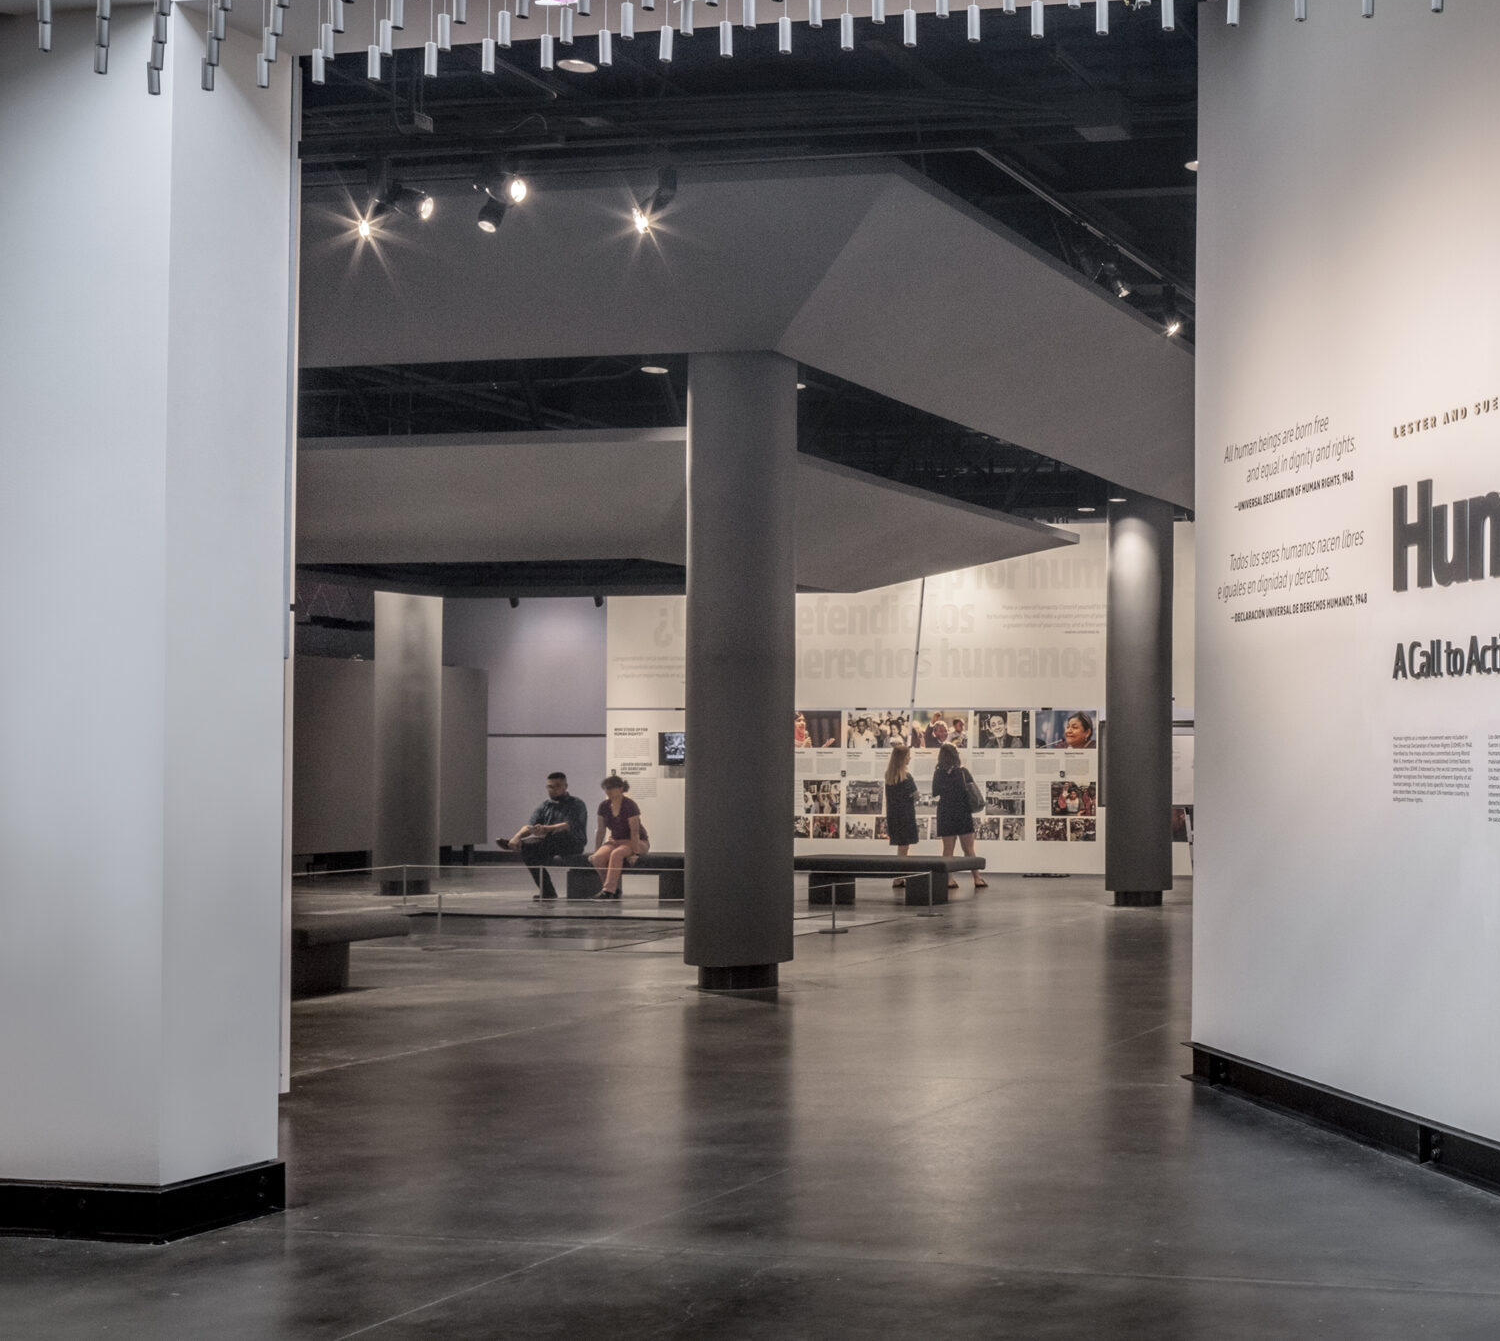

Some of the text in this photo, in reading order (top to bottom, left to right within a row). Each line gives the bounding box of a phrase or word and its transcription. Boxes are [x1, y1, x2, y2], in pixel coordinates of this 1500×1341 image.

[1224, 414, 1329, 464] All human beings are born free
[1392, 415, 1438, 440] LESTER
[1442, 406, 1468, 427] AND
[1474, 396, 1499, 417] SUE
[1246, 462, 1260, 483] and
[1261, 456, 1280, 481] equal
[1281, 453, 1288, 473] in
[1289, 446, 1315, 473] dignity
[1316, 439, 1331, 463] and
[1263, 486, 1294, 505] DECLARATION
[1295, 485, 1301, 496] OF
[1302, 479, 1320, 495] HUMAN
[1321, 474, 1341, 489] RIGHTS,
[1342, 470, 1354, 484] 1948
[1230, 529, 1364, 571] Todos los seres humanos nacen libres
[1217, 586, 1222, 599] e
[1223, 579, 1246, 603] iguales
[1247, 579, 1256, 595] en
[1257, 570, 1288, 597] dignidad
[1289, 572, 1293, 592] y
[1266, 604, 1292, 618] UNIVERSAL
[1293, 603, 1299, 615] DE
[1300, 599, 1326, 613] DERECHOS
[1327, 594, 1354, 609] HUMANOS,
[1355, 592, 1367, 605] 1948
[1392, 642, 1408, 680] A
[1409, 638, 1442, 679] Call
[1444, 641, 1464, 677] to
